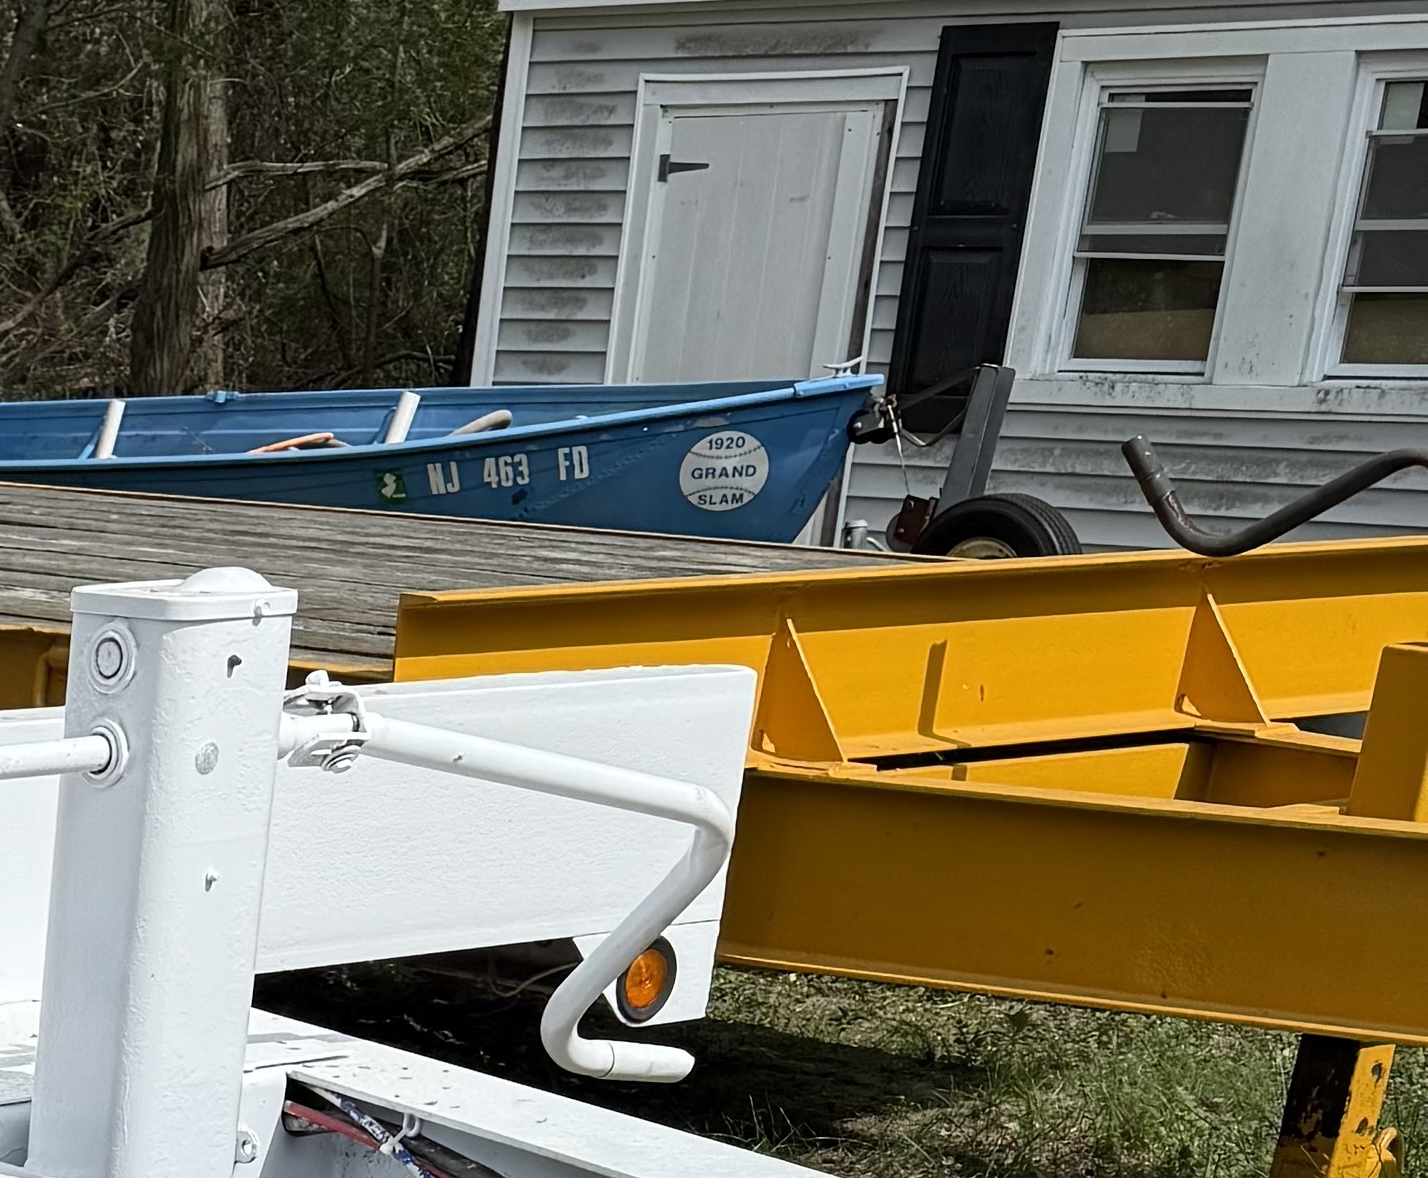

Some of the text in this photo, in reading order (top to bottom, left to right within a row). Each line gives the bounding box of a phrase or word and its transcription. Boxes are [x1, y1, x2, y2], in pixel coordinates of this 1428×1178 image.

[707, 436, 746, 451] 1920
[426, 445, 590, 495] NJ 463 FD
[691, 464, 757, 480] GRAND
[697, 492, 745, 506] SLAM
